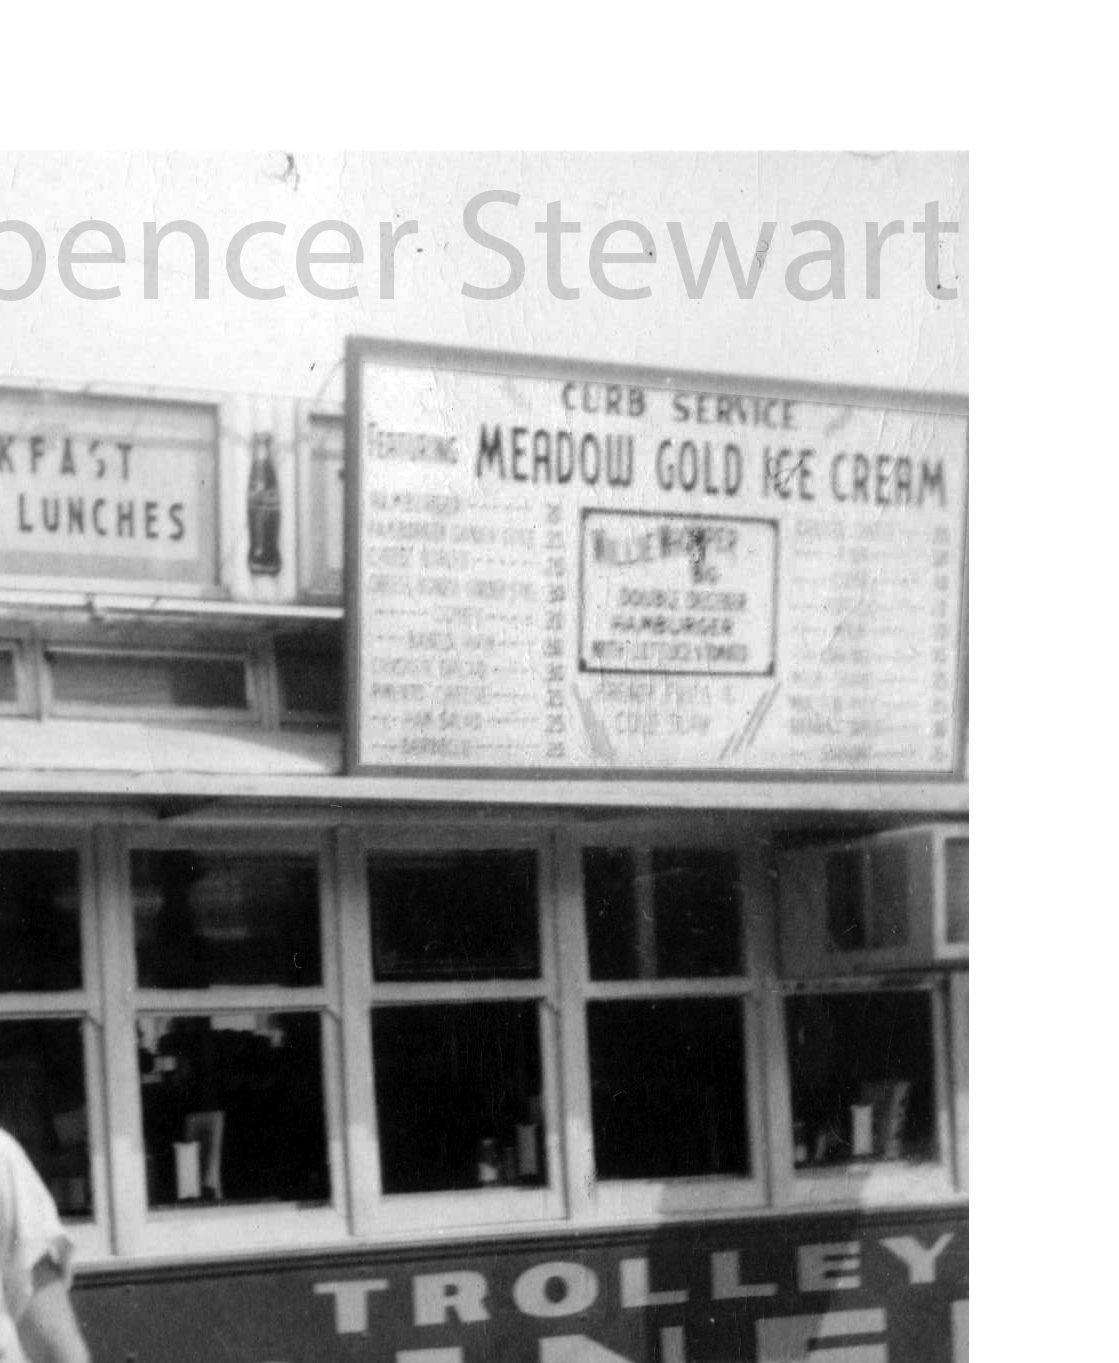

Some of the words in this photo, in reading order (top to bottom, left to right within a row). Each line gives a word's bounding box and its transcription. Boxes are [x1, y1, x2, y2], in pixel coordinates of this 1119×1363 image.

[561, 379, 647, 418] CURB
[672, 390, 800, 431] SERVICE
[475, 422, 636, 490] MEADOW
[654, 436, 744, 498] GOLD
[761, 445, 818, 502] ICE
[830, 451, 951, 510] CREAM
[17, 491, 185, 542] LUNCHES
[313, 1232, 956, 1335] TROLLEY
